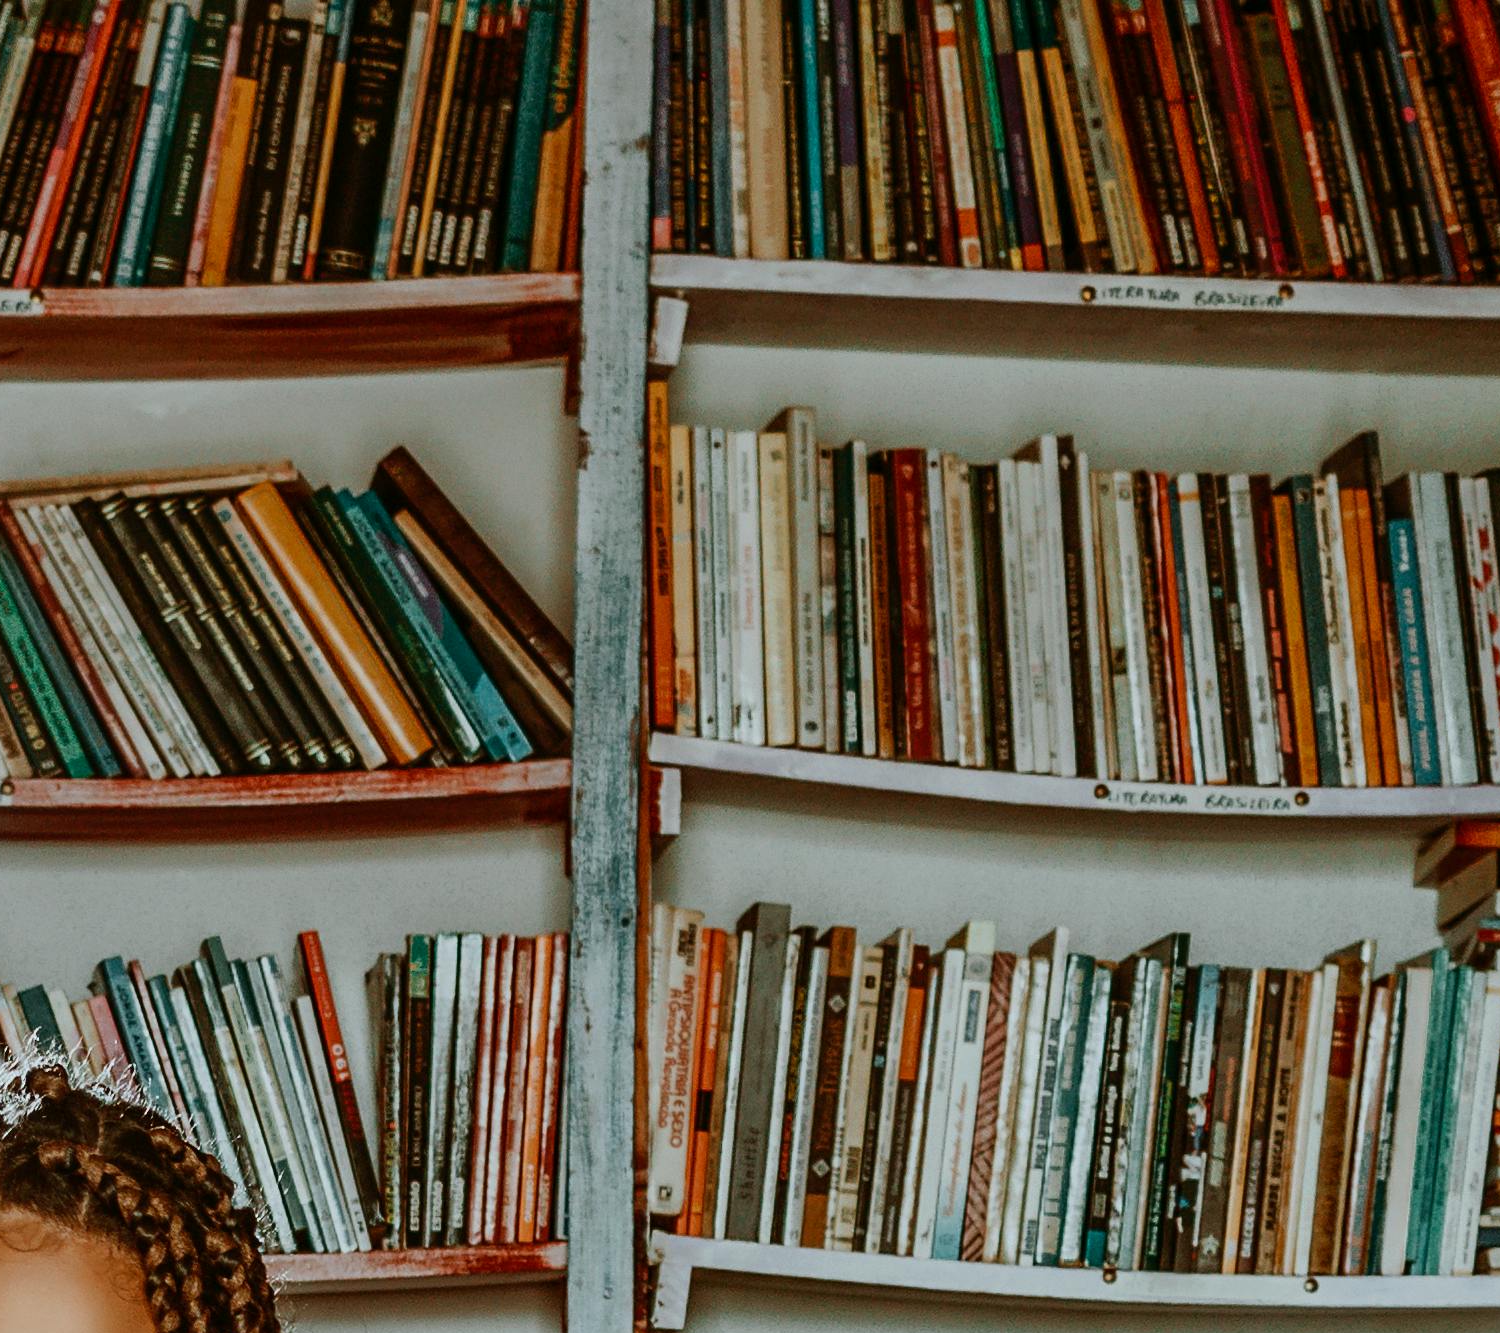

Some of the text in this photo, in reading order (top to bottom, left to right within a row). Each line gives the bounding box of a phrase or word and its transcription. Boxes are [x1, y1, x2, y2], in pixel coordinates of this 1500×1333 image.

[1195, 290, 1284, 309] BRASILEIRA
[1205, 792, 1290, 811] BRASILEIRA
[667, 1109, 685, 1150] SEXO
